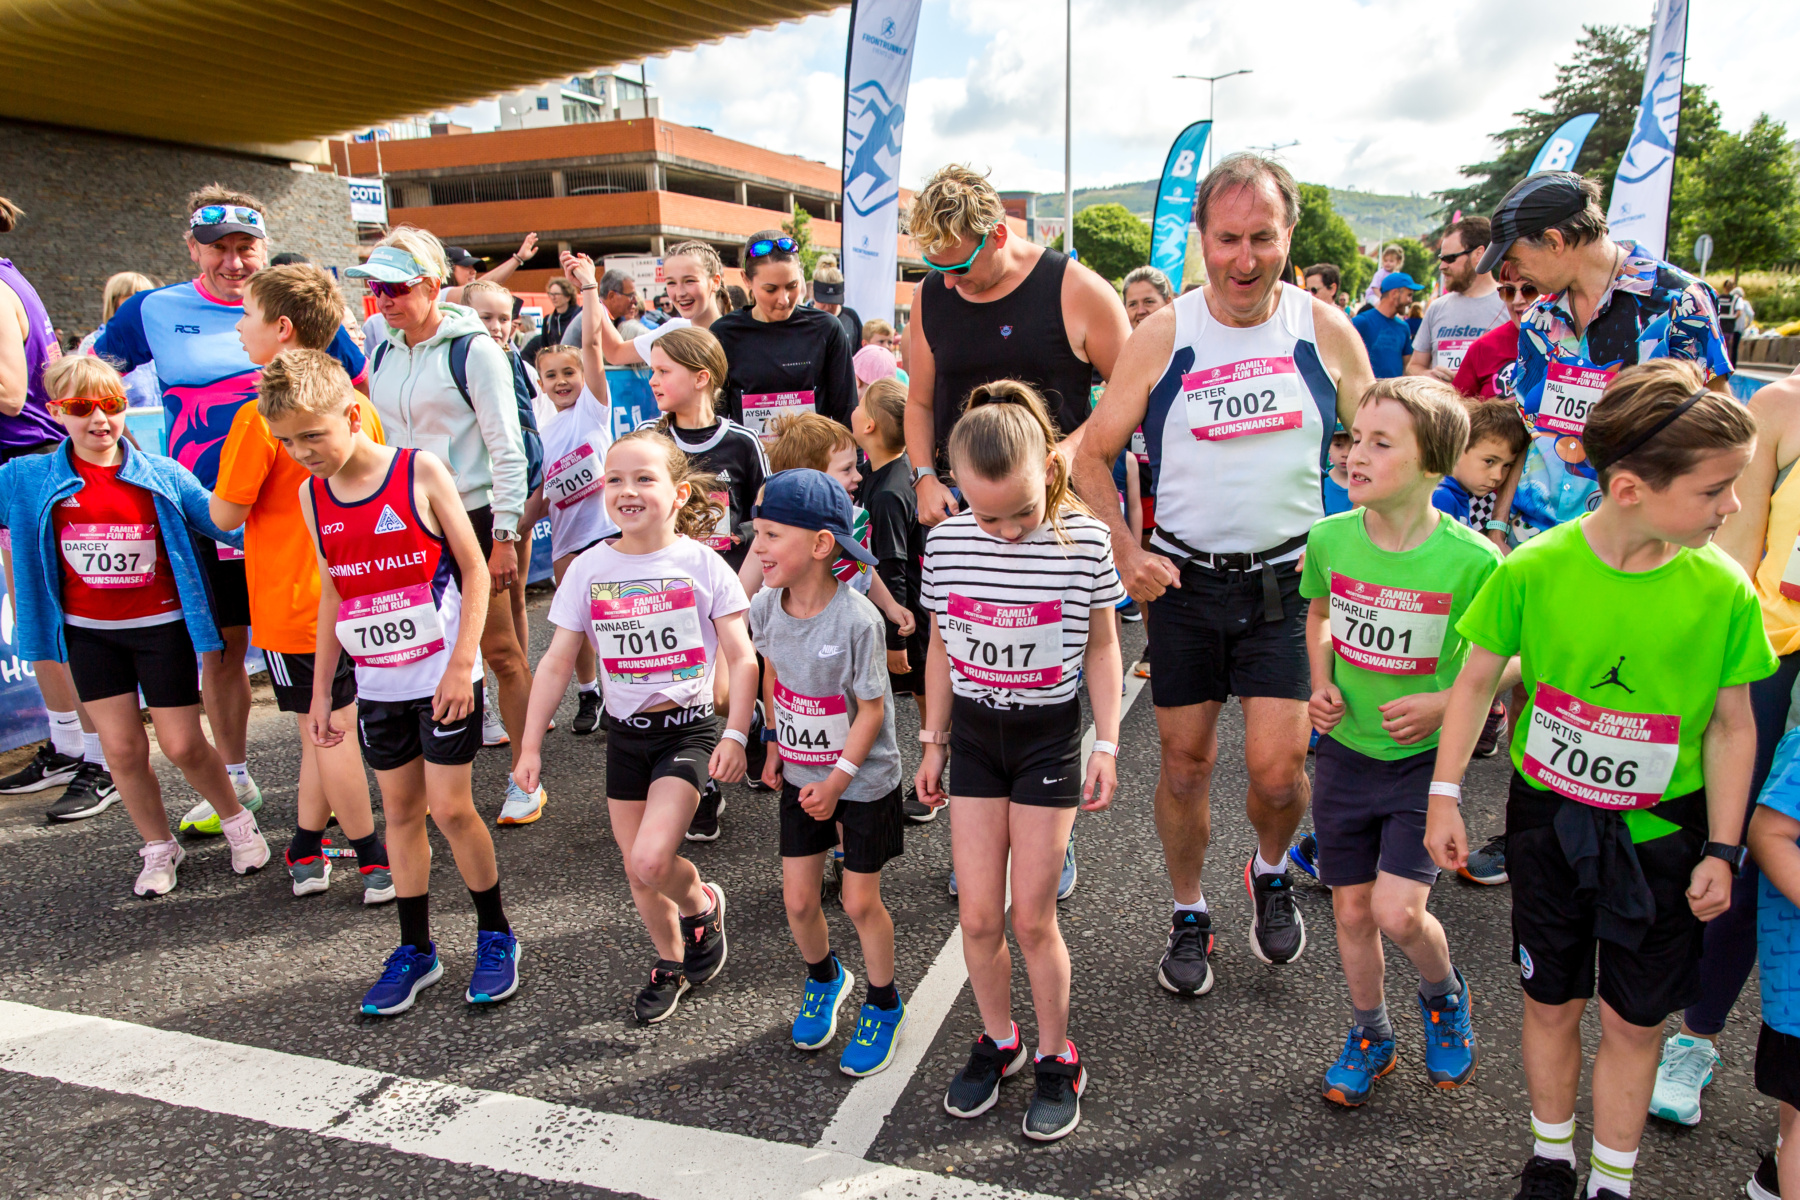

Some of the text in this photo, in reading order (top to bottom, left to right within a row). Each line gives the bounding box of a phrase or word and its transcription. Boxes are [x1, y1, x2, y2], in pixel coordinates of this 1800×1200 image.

[1538, 137, 1575, 170] B
[1171, 149, 1196, 178] B
[350, 186, 381, 202] COTT
[174, 324, 200, 334] RCS
[1437, 325, 1490, 338] finister
[1235, 360, 1267, 372] FAMILY
[1447, 357, 1461, 368] 70
[1232, 366, 1273, 381] FUN RUN
[1580, 371, 1606, 381] FAMILY
[1547, 383, 1564, 393] PAUL
[1576, 378, 1591, 387] FUN
[1591, 380, 1607, 388] RUN
[1187, 387, 1226, 402] PETER
[1208, 390, 1277, 421] 7002
[1208, 416, 1284, 437] #RUNSWANSEA
[545, 477, 561, 490] CORA
[556, 469, 593, 496] 7019
[65, 543, 108, 551] DARCEY
[82, 553, 141, 571] 7037
[375, 550, 427, 571] VALLEY
[372, 592, 405, 605] FAMILY
[633, 594, 667, 606] FAMILY
[1380, 589, 1420, 602] FAMILY
[371, 598, 411, 614] FUN RUN
[631, 601, 672, 616] FUN RUN
[1331, 597, 1378, 621] CHARLIE
[1374, 597, 1423, 611] FUN RUN
[996, 607, 1034, 618] FAMILY
[595, 620, 645, 632] ANNABEL
[948, 619, 973, 634] EVIE
[992, 616, 1038, 627] FUN RUN
[354, 619, 416, 648] 7089
[613, 627, 677, 655] 7016
[1345, 616, 1412, 654] 7001
[821, 644, 839, 653] NIKE
[966, 637, 1036, 667] 7017
[617, 653, 687, 669] #RUNSWANSEA
[1340, 644, 1416, 670] #RUNSWANSEA
[963, 665, 1042, 683] #RUNSWANSEA
[790, 703, 825, 715] FUN RUN
[793, 696, 820, 707] FAMILY
[619, 702, 714, 728] RO NIKE
[1598, 713, 1648, 729] FAMILY
[779, 719, 830, 749] 7044
[1535, 712, 1582, 744] CURTIS
[1590, 722, 1651, 740] FUN RUN
[778, 747, 839, 762] RUNSWANSEA
[1550, 737, 1639, 788] 7066
[1537, 768, 1637, 806] #RUNSWANSEA
